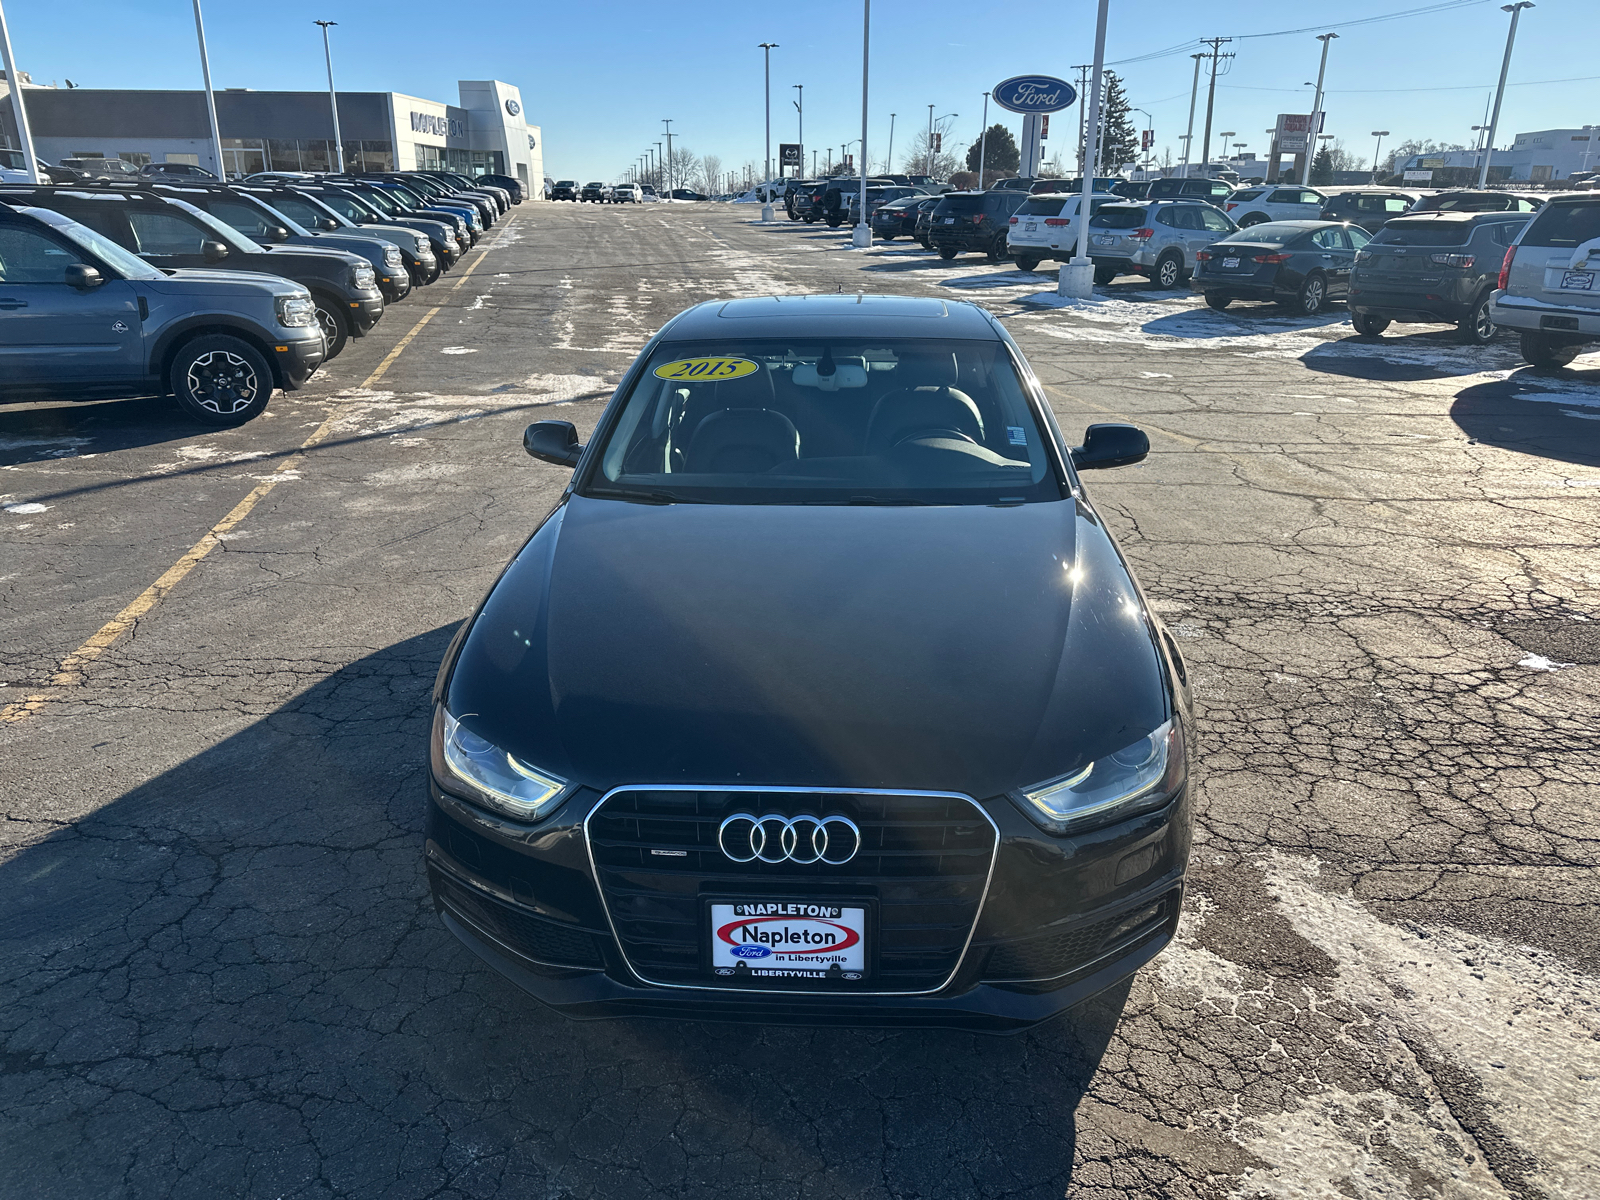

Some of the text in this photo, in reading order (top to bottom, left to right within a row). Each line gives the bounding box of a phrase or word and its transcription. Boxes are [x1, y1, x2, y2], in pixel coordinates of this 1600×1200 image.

[1012, 82, 1061, 105] Ford
[410, 111, 464, 138] NAPLETON
[668, 360, 743, 377] 2015
[743, 904, 831, 917] NAPLETON
[742, 925, 836, 947] Napleton
[739, 947, 764, 957] Ford
[775, 954, 848, 963] in Libertyville
[751, 969, 826, 979] LIBERTYVILLE
